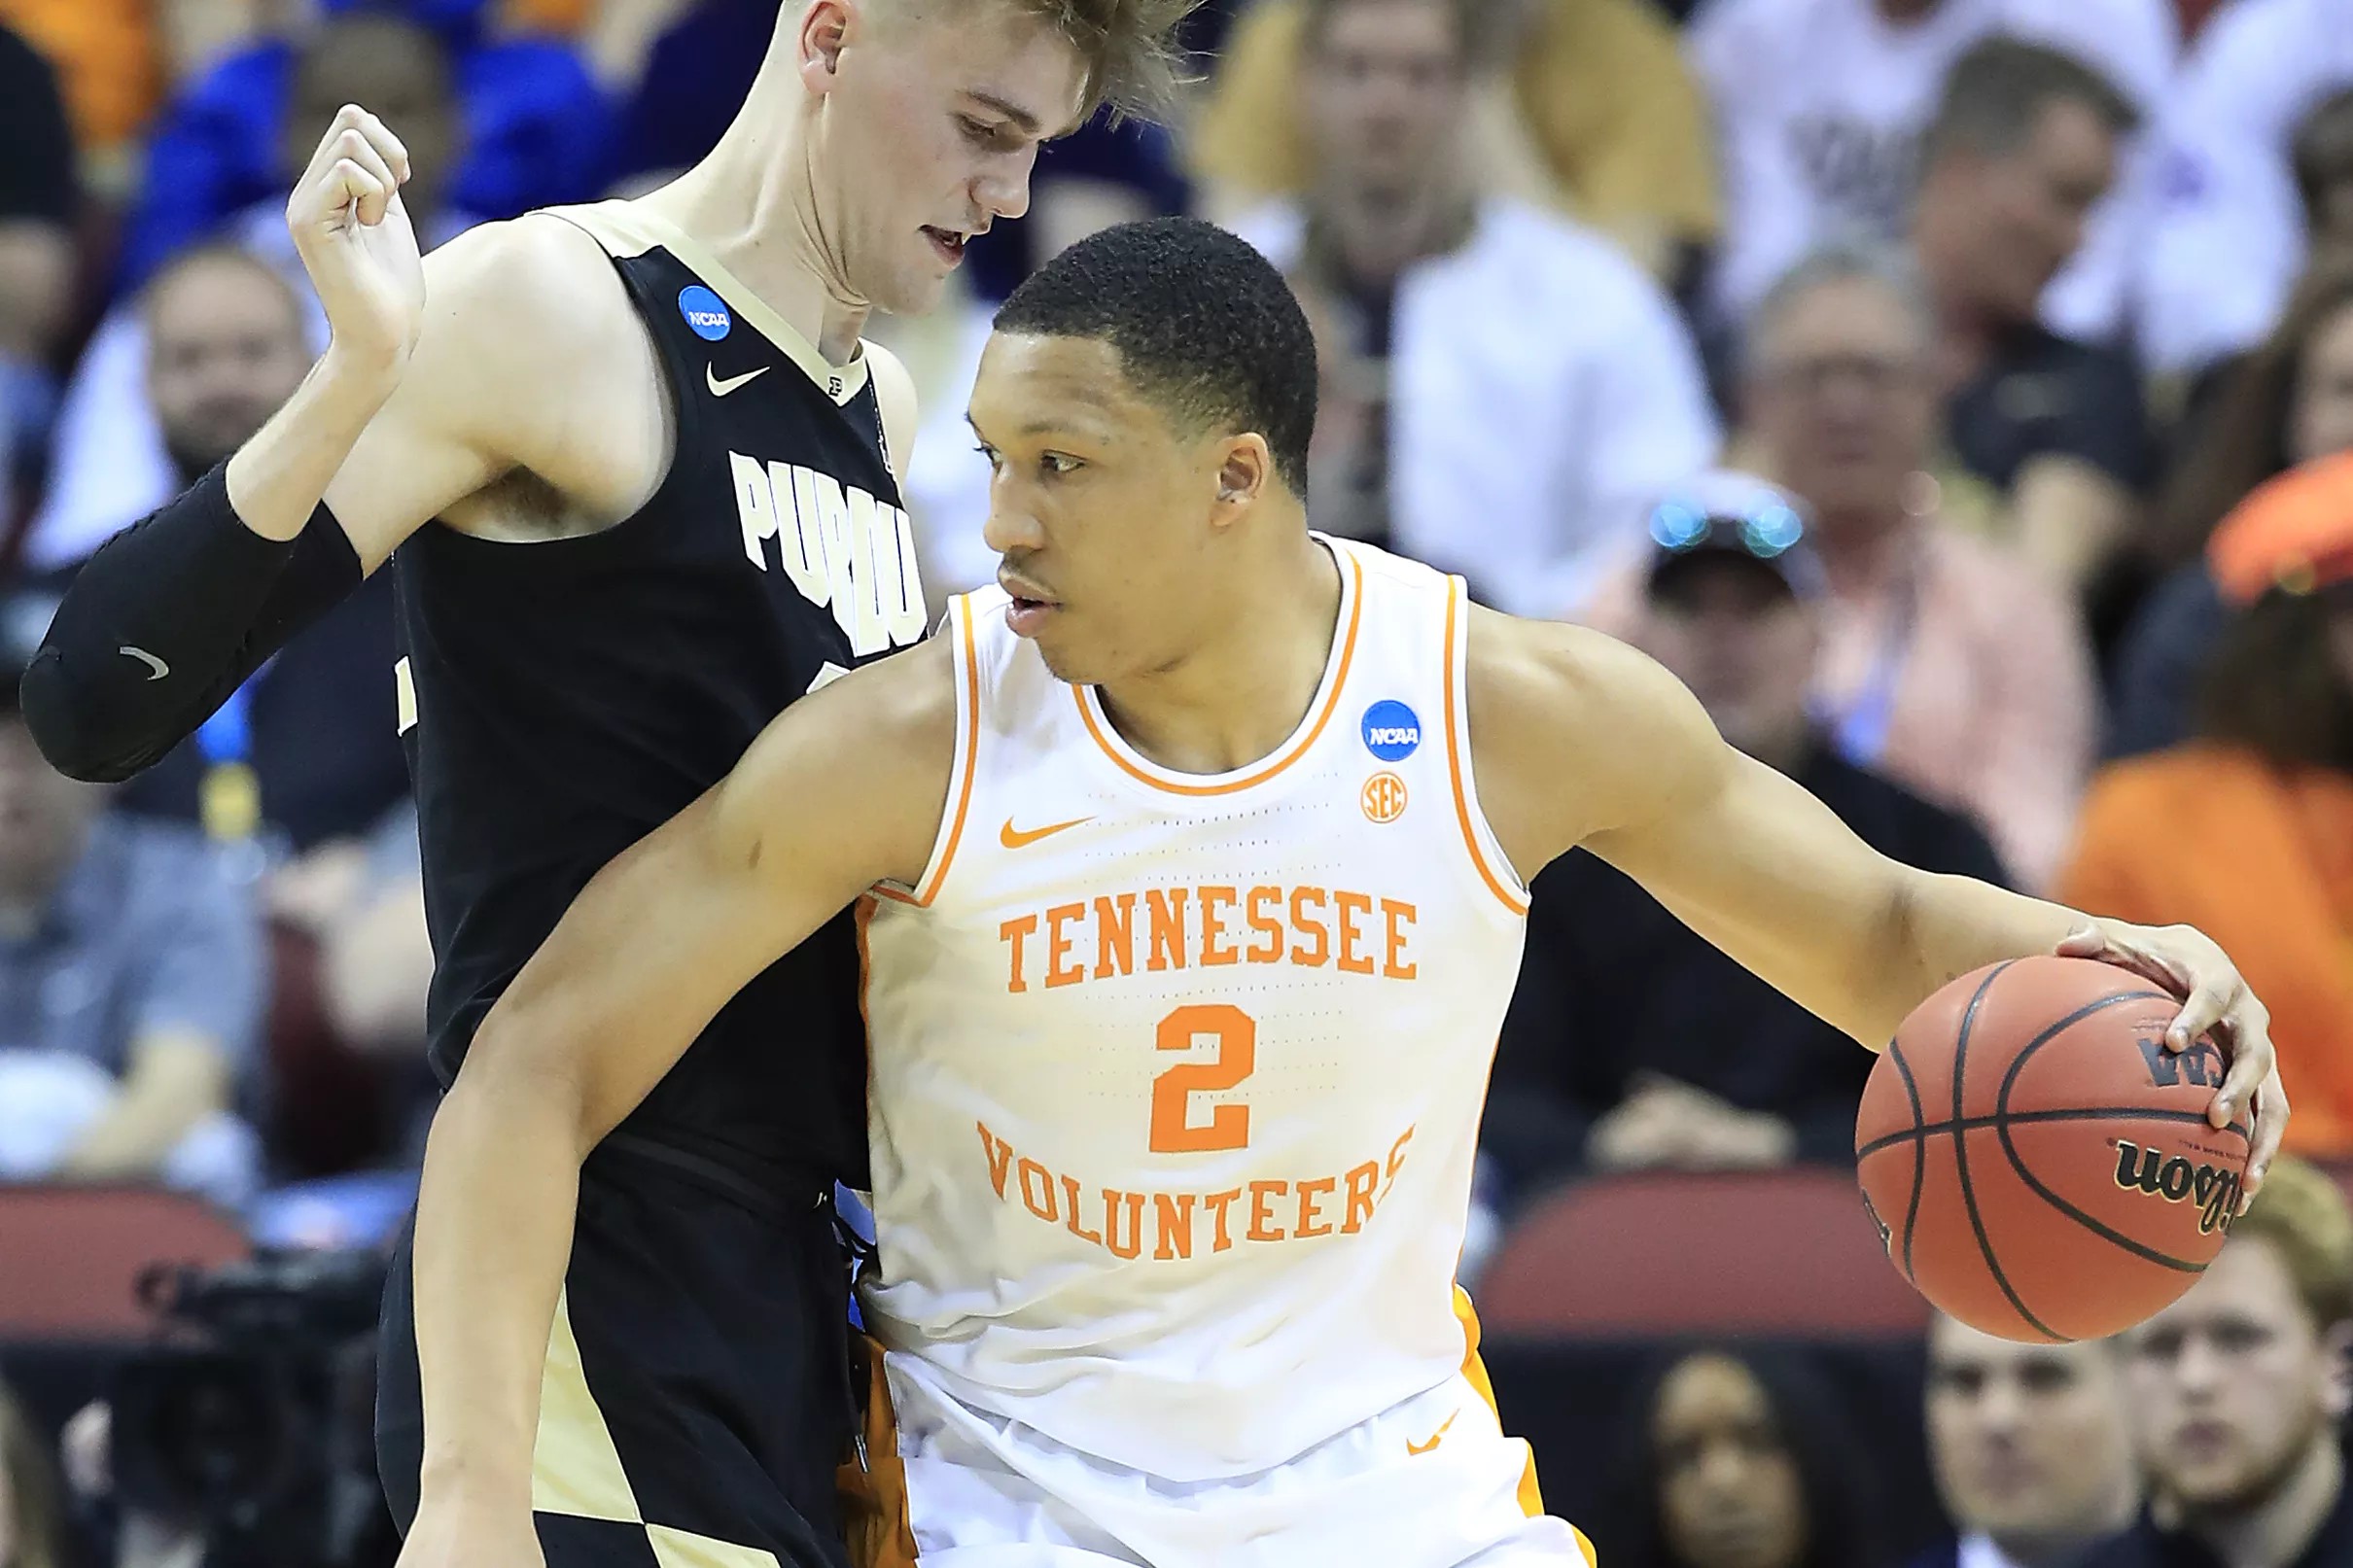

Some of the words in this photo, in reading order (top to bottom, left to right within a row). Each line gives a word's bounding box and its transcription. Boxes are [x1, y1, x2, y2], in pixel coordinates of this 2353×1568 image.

[688, 311, 729, 327] NCAA
[728, 449, 929, 658] PURDU
[1370, 727, 1419, 746] NCAA
[1365, 777, 1403, 819] SEC
[999, 885, 1419, 993] TENNESSEE
[1148, 1003, 1256, 1153] 2
[976, 1119, 1416, 1261] VOLUNTEERS
[2114, 1139, 2242, 1237] ilson
